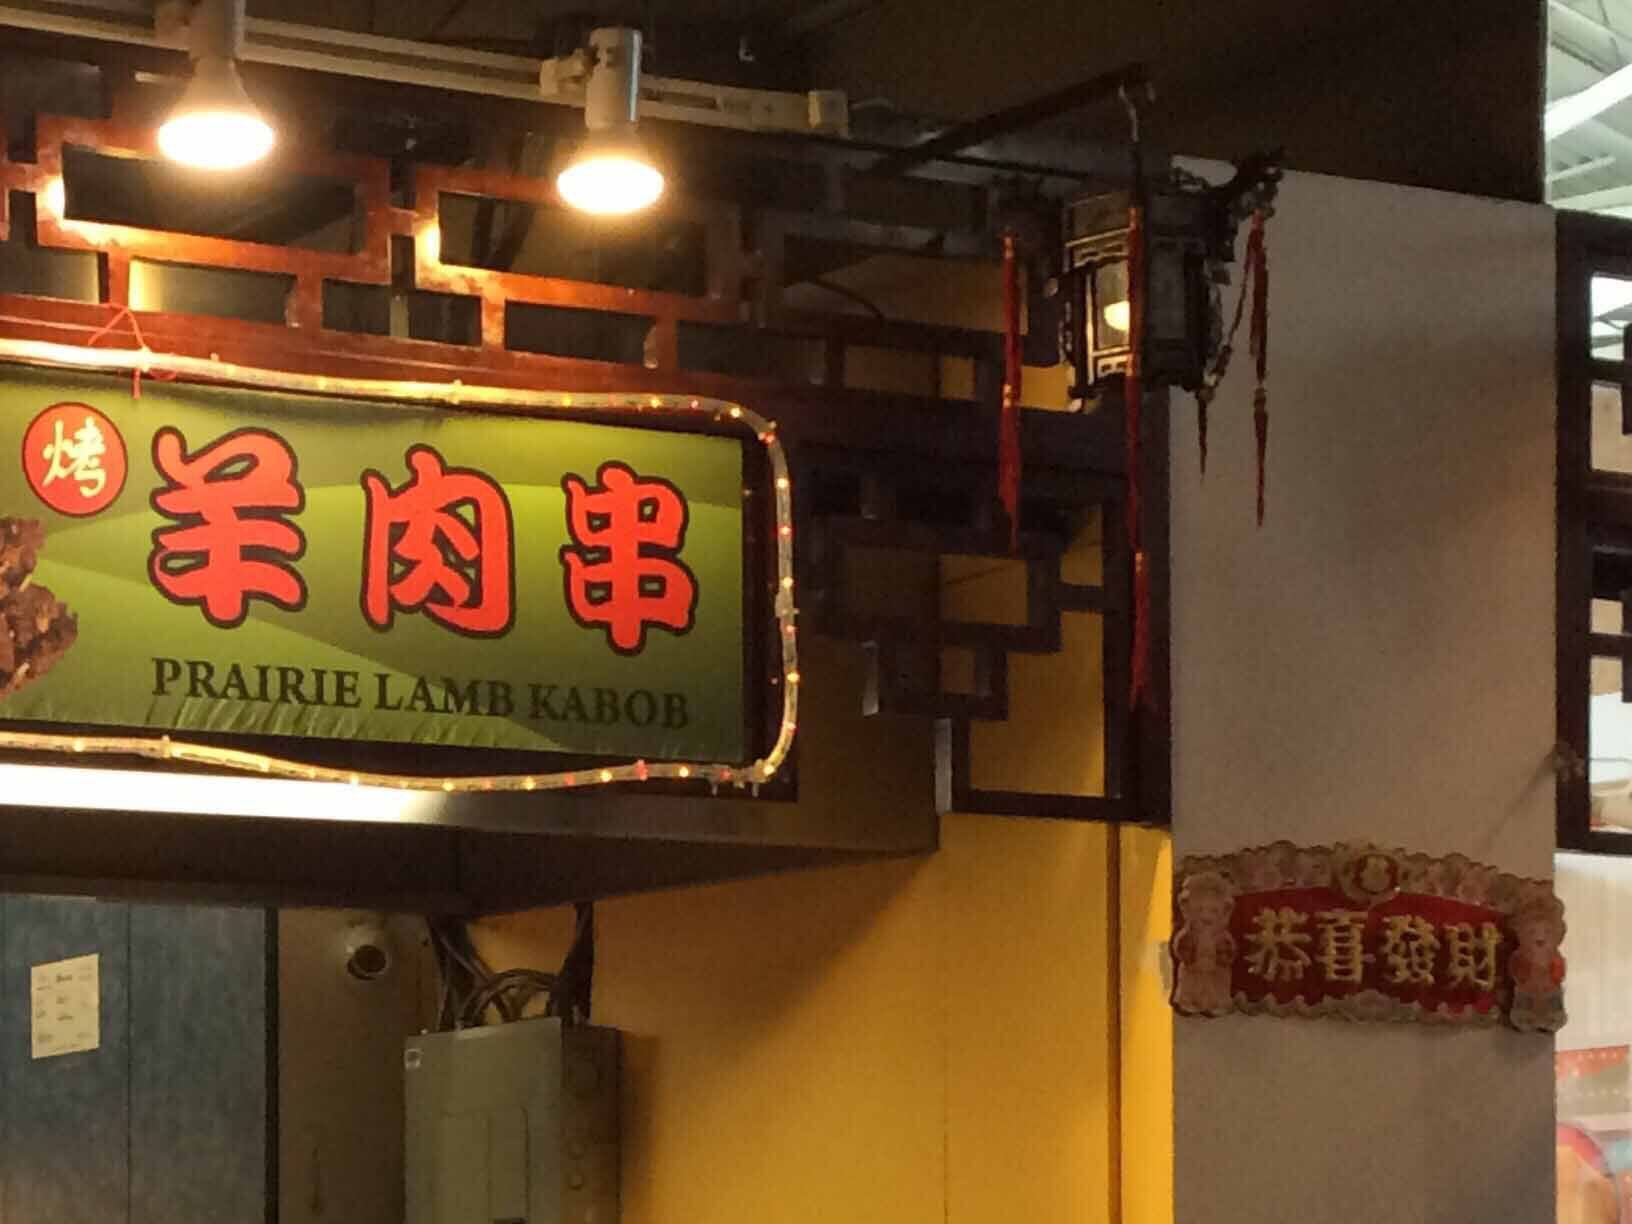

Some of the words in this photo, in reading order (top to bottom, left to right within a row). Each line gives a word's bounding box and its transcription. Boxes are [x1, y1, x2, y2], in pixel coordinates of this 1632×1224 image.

[40, 414, 109, 499] 烤
[148, 426, 699, 656] 羊肉串
[150, 657, 362, 709] PRAIRIE
[374, 672, 516, 719] LAMB
[528, 683, 690, 731] KABOB
